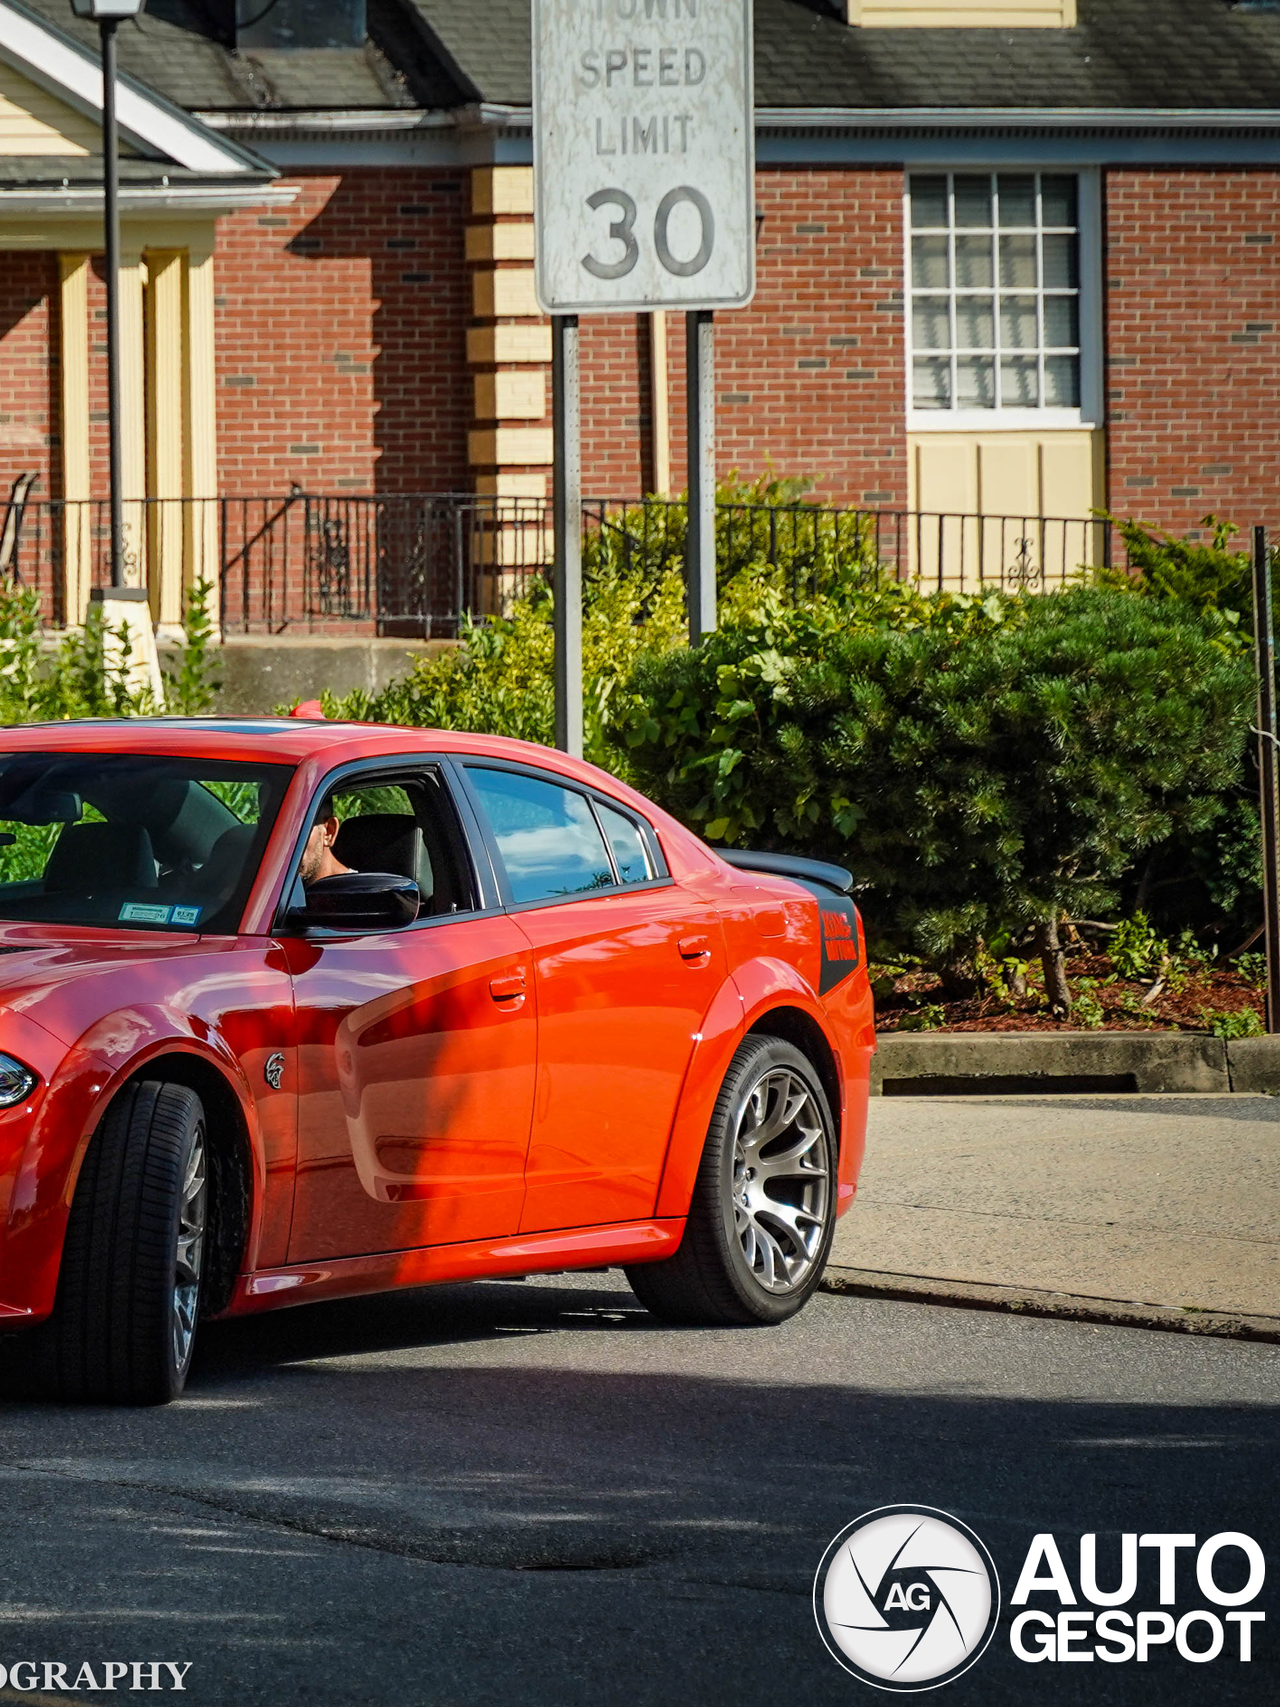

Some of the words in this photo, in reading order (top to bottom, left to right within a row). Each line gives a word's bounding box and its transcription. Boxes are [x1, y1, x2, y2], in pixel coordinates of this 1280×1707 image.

[579, 48, 707, 88] SPEED
[595, 115, 694, 156] LIMIT
[580, 184, 715, 280] 30
